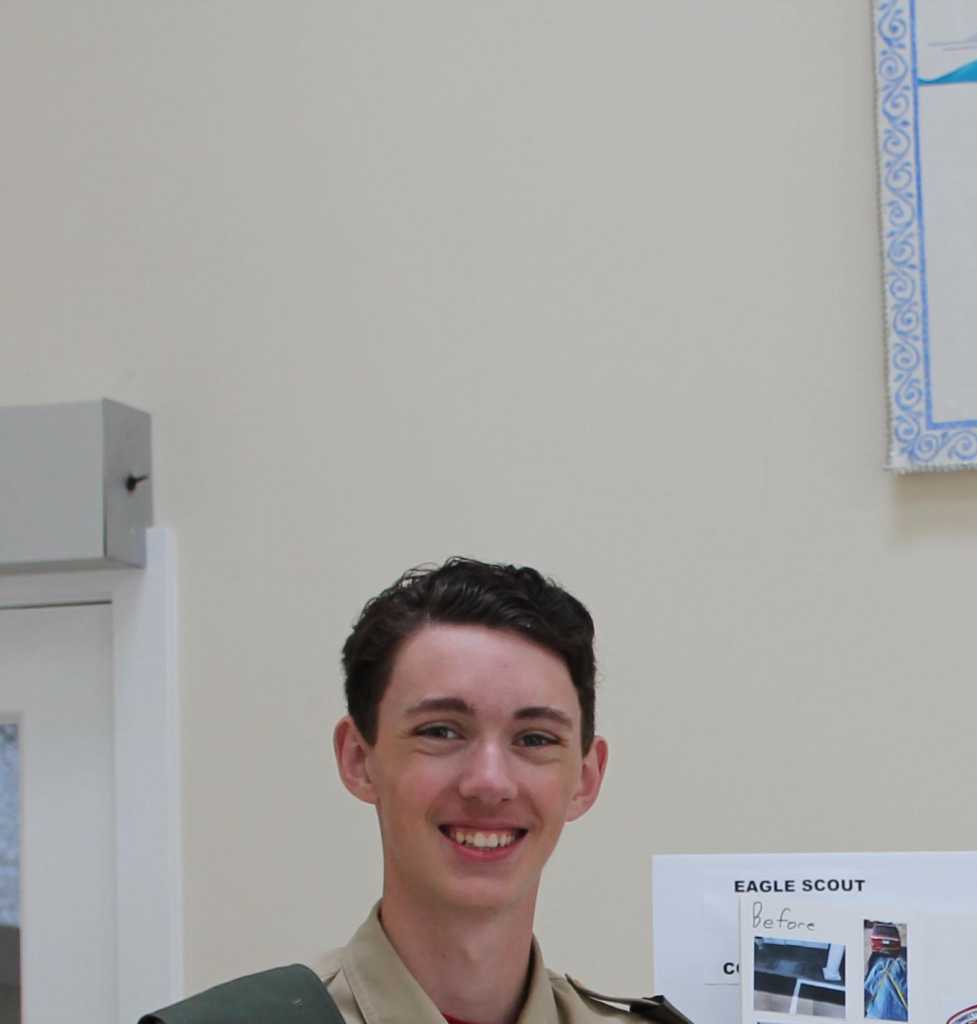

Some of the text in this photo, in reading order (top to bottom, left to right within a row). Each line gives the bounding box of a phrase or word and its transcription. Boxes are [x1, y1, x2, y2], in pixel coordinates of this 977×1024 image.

[734, 878, 866, 893] EAGLE SCOUT
[752, 900, 816, 931] Before
